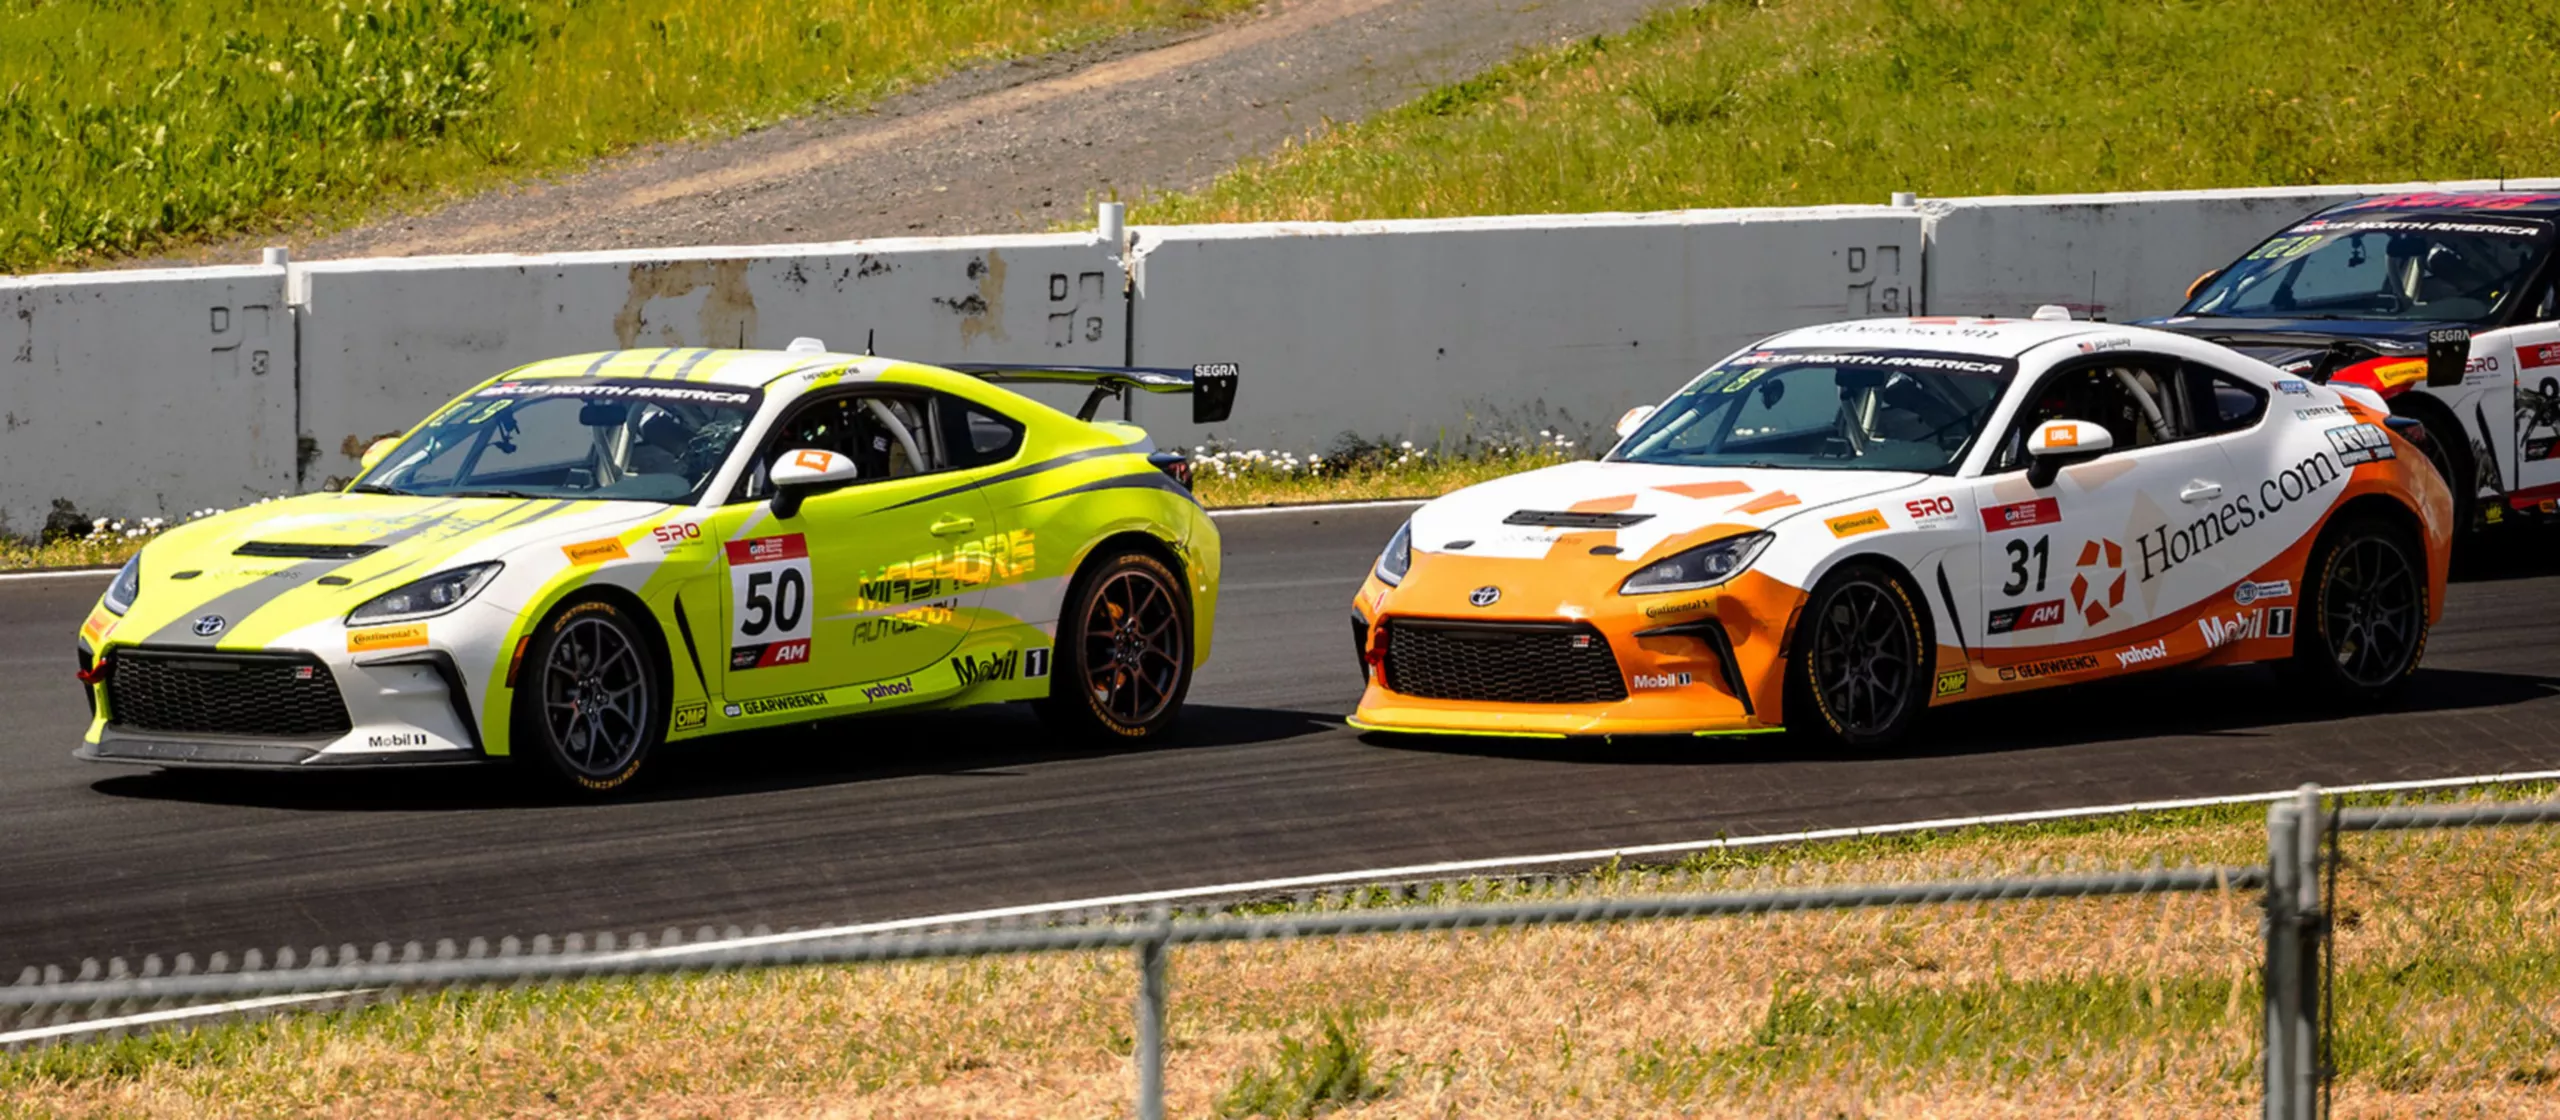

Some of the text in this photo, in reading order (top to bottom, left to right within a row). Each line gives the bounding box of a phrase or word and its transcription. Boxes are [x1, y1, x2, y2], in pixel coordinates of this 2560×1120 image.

[2352, 221, 2429, 231] NORTH
[2428, 222, 2539, 236] AMERICA
[2428, 329, 2471, 344] SEGRA
[1194, 363, 1238, 378] SEGRA
[1804, 352, 1879, 366] NORTH
[1880, 355, 2003, 374] AMERICA
[548, 384, 633, 398] NORTH
[635, 385, 750, 403] AMERICA
[1904, 495, 1955, 519] SRO
[2135, 451, 2341, 583] Homes.com
[652, 522, 701, 543] SRO
[2002, 534, 2049, 597] 31
[740, 567, 806, 637] 50
[1645, 600, 1701, 618] Continental
[2031, 604, 2060, 624] AM
[353, 629, 411, 646] Continental
[2197, 607, 2264, 649] Mobil
[775, 643, 807, 662] AM
[2114, 639, 2168, 669] yahoo!
[951, 649, 1018, 687] Mobil
[2017, 655, 2100, 679] GEARWRENCH
[861, 677, 914, 704] yahoo!
[1633, 672, 1676, 689] Mobil
[1937, 674, 1966, 693] OMP
[743, 692, 829, 715] GEARWRENCH
[676, 708, 706, 727] OMP
[368, 734, 411, 748] Mobil
